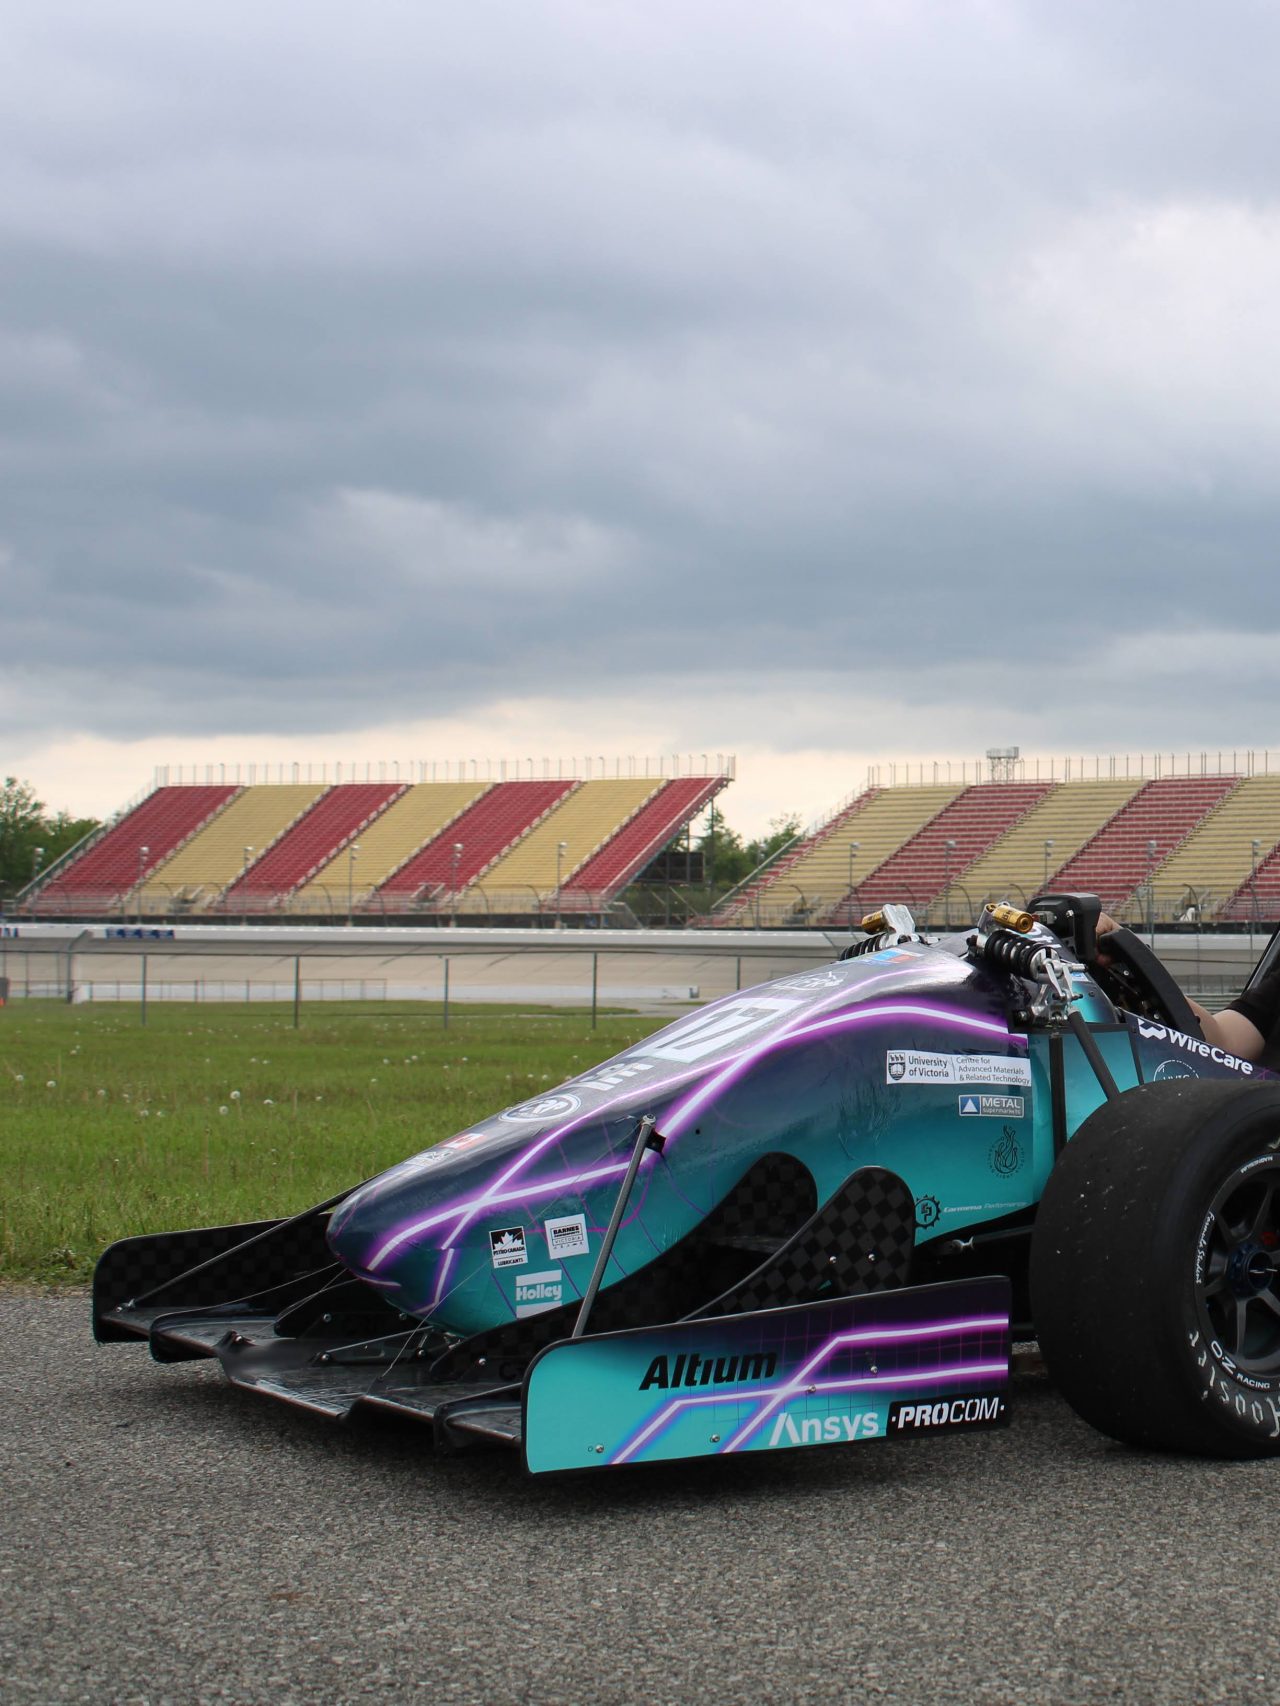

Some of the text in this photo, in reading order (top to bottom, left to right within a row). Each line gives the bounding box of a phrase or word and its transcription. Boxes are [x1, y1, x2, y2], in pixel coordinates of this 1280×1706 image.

[1166, 1028, 1254, 1075] WireCare
[908, 1055, 948, 1068] University
[908, 1067, 949, 1078] of Victoria
[958, 1065, 1024, 1075] Advanced Materials
[966, 1073, 991, 1081] Related
[992, 1074, 1030, 1085] Technology
[982, 1097, 1021, 1108] METAL
[515, 1284, 562, 1301] Holley
[638, 1351, 778, 1391] Altium
[1236, 1373, 1271, 1389] RACING
[768, 1411, 879, 1447] Ansys
